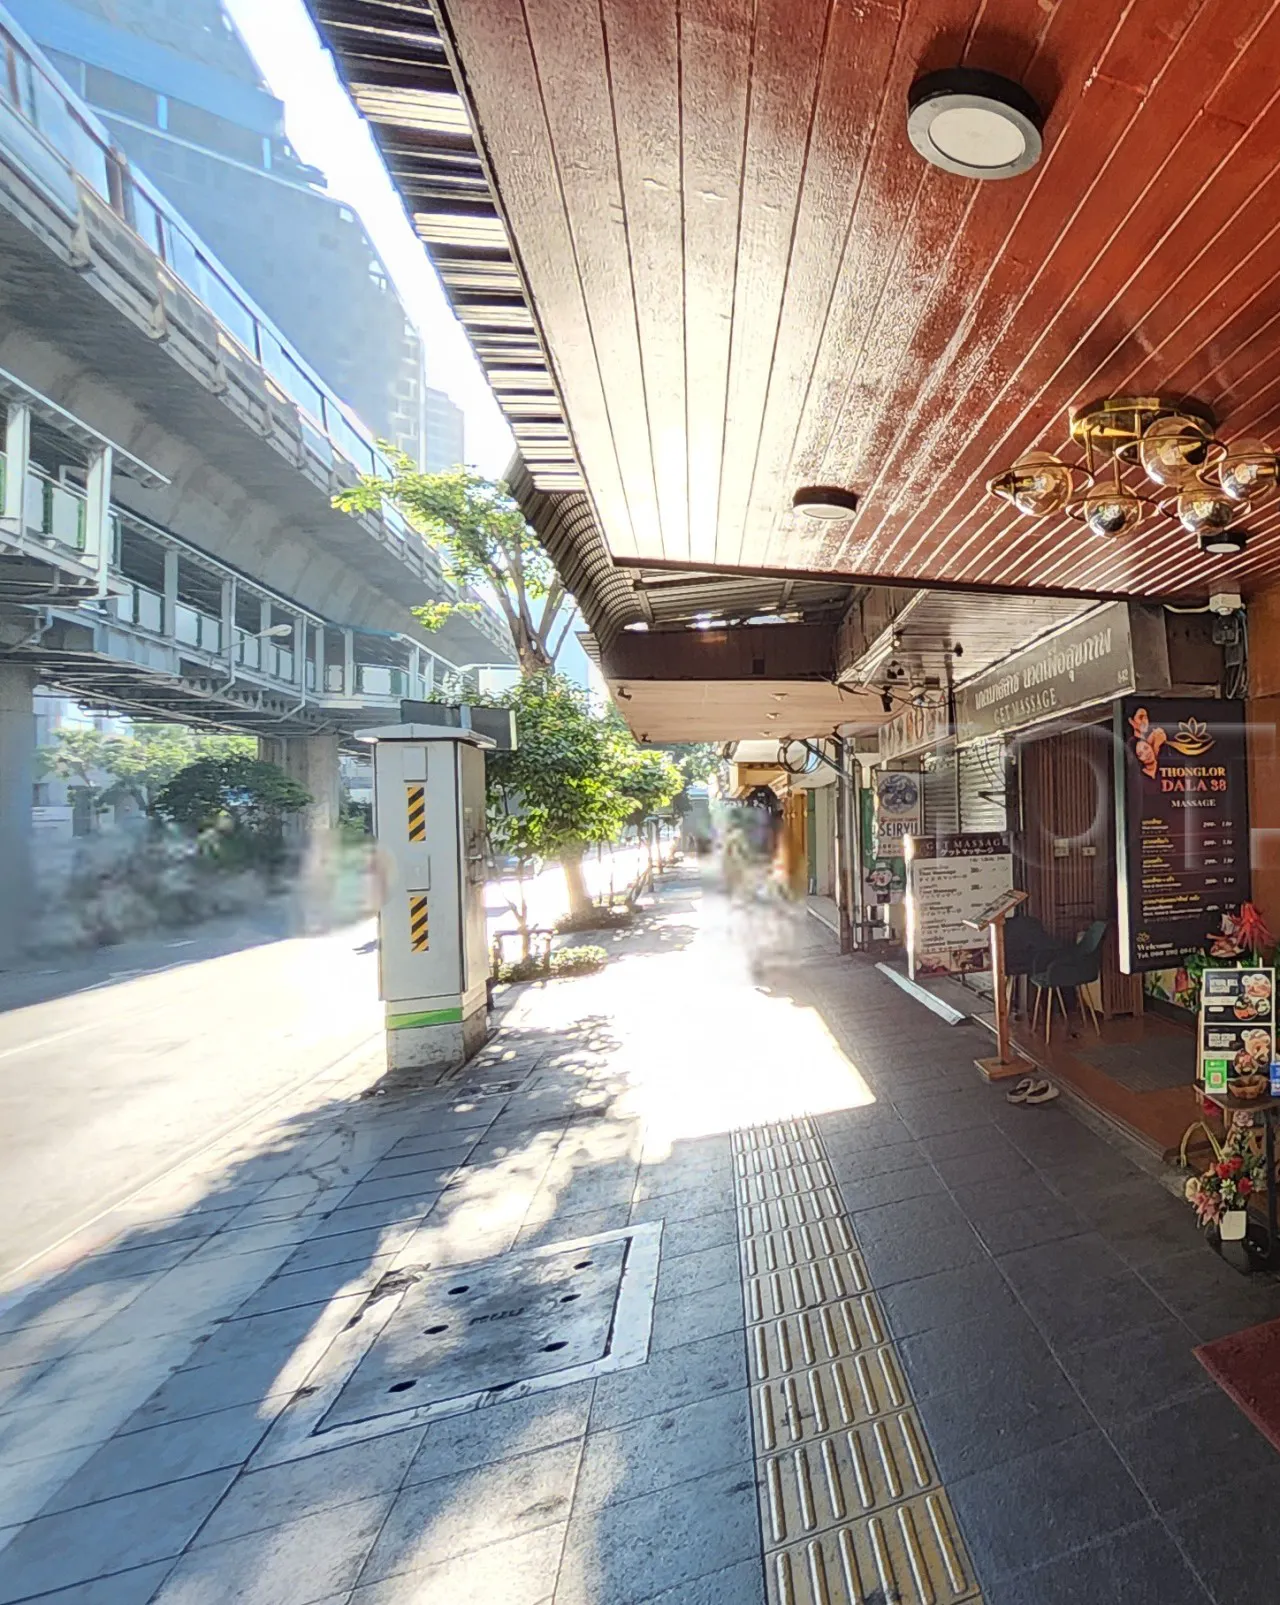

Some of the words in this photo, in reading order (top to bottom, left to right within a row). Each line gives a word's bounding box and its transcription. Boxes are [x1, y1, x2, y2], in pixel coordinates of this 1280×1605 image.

[993, 705, 1011, 725] GET
[1011, 687, 1057, 719] MASSAGE
[1160, 767, 1226, 777] THONGLOR
[1161, 779, 1207, 792] DALA
[1211, 779, 1226, 791] 38
[1171, 799, 1216, 807] MASSAGE
[879, 822, 918, 836] SEIRYU
[953, 839, 1009, 849] MASSAGE
[1137, 943, 1174, 951] Welcome
